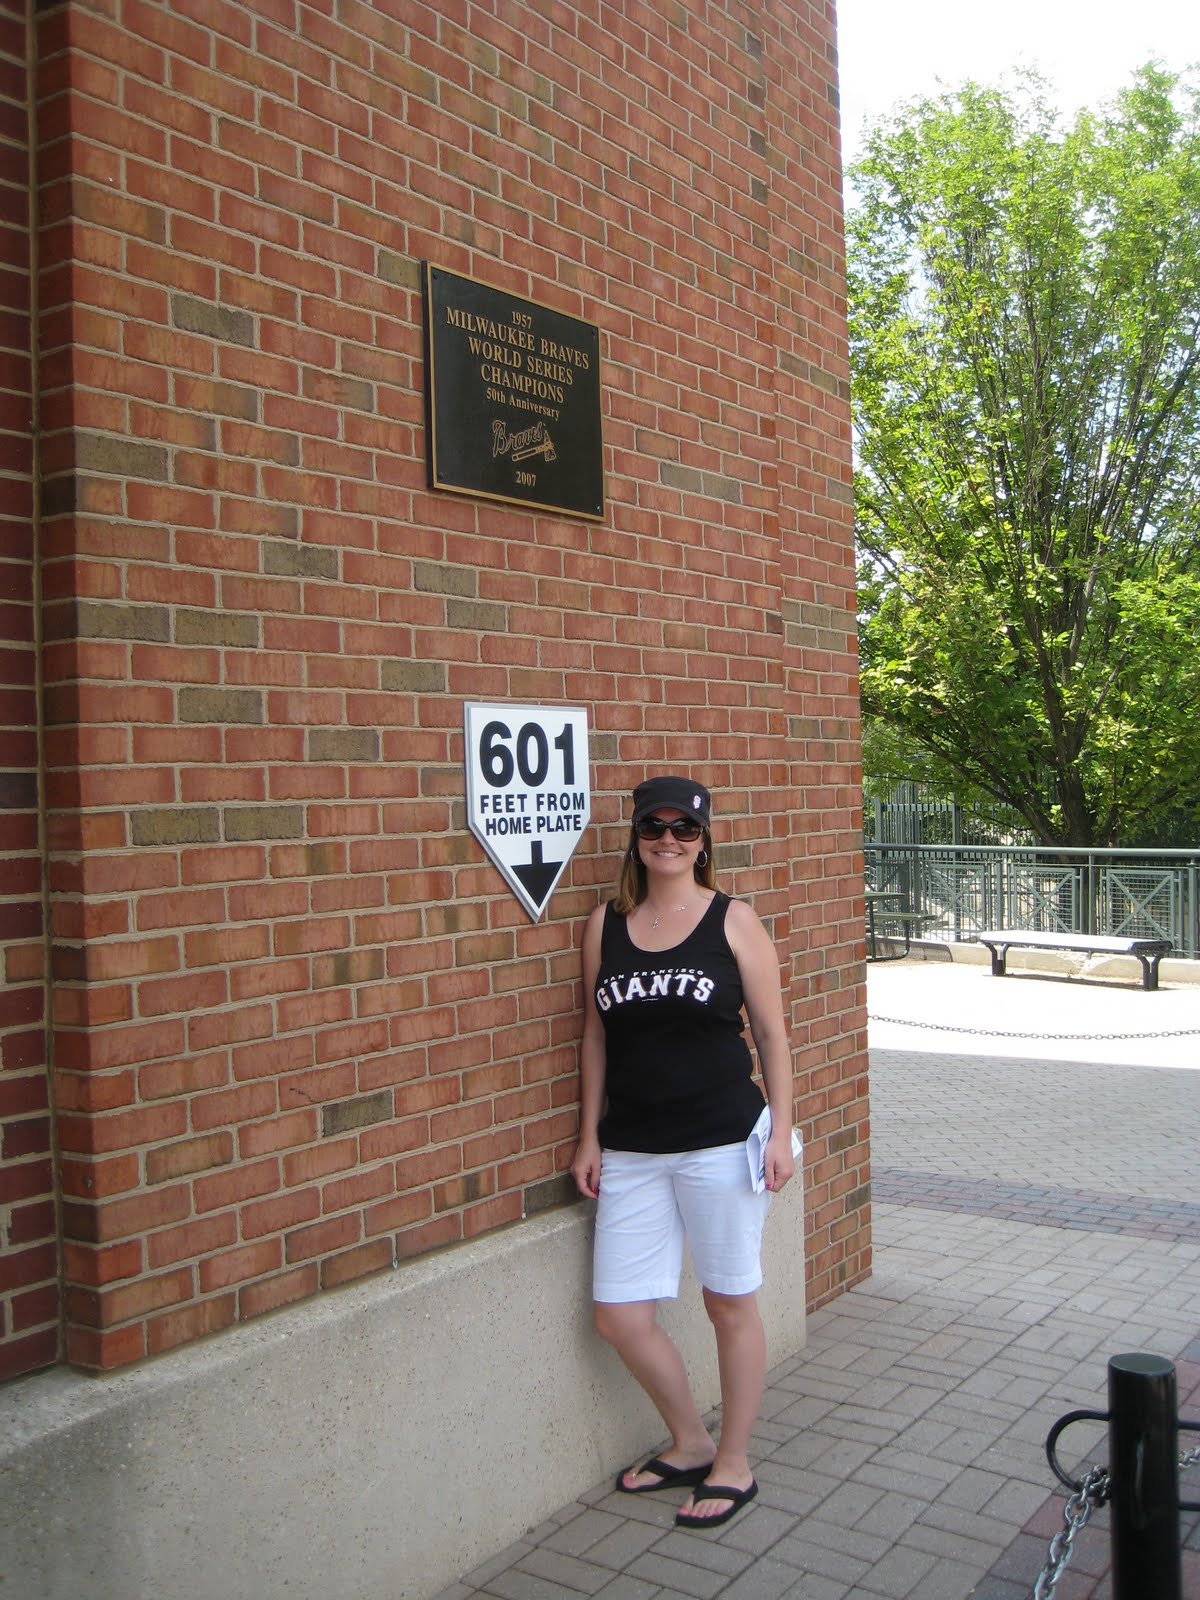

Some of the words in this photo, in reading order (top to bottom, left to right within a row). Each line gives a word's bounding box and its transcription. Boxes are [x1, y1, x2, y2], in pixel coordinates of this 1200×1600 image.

[511, 310, 532, 329] 1957
[446, 307, 535, 351] MILWAUKEE
[541, 338, 590, 370] BRAVES
[468, 336, 522, 368] WORLD
[527, 355, 573, 385] SERIES
[481, 364, 564, 403] CHAMPIONS
[486, 387, 506, 403] 50th
[509, 394, 560, 421] Anniversary
[493, 420, 543, 457] Braves
[516, 471, 536, 487] 2007
[479, 720, 575, 788] 601
[480, 794, 528, 814] FEET
[536, 792, 585, 812] FROM
[485, 816, 532, 836] HOME
[536, 814, 582, 834] PLATE
[596, 973, 715, 1011] GIANTS
[603, 974, 625, 985] SAN
[633, 968, 704, 977] FRANCISCO
